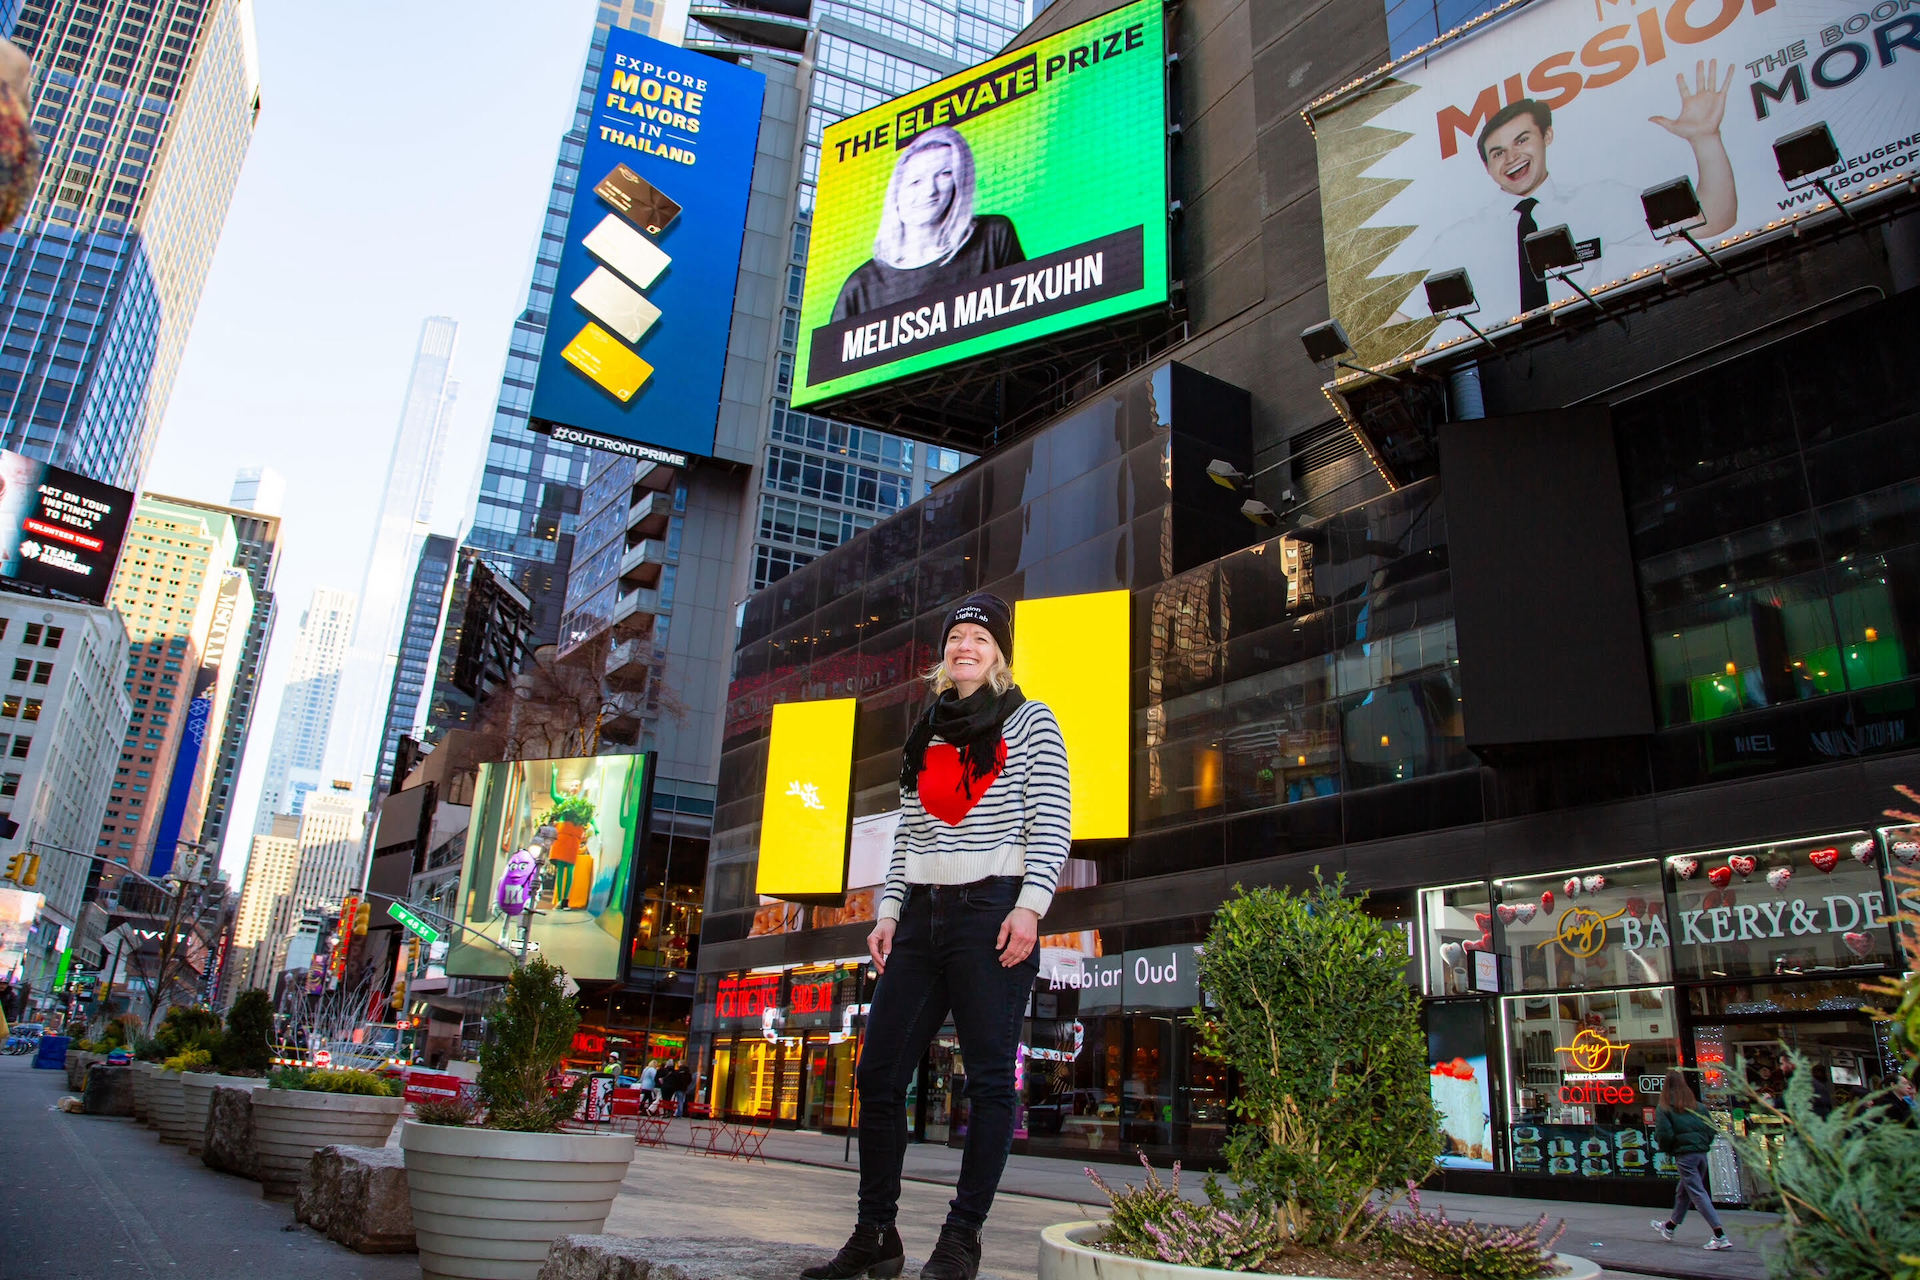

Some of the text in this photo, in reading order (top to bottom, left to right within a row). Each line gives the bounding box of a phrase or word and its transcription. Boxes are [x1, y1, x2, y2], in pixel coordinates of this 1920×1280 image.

[615, 53, 708, 92] EXPLORE
[1745, 39, 1808, 78] THE
[611, 69, 703, 115] MORE
[835, 23, 1144, 163] THE ELEVATE PRIZE
[1436, 0, 1776, 160] MISSIO
[606, 93, 700, 133] FLAVORS
[639, 121, 662, 138] IN
[600, 125, 696, 165] THAILAND
[841, 252, 1104, 363] MELISSA MALZKUHN
[553, 427, 685, 466] #OUTFRONTPRIME
[38, 484, 111, 514] ACT ON YOUR
[42, 496, 101, 521] INSTINCTS
[28, 521, 100, 548] VOLUNTEER TODAY
[45, 507, 93, 530] TO HELP.
[39, 552, 93, 576] RUBICON
[43, 544, 77, 562] TEAM
[955, 611, 973, 620] Light
[398, 911, 429, 937] W 48 St
[1134, 952, 1177, 985] Oud
[588, 1078, 599, 1120] CHICAGO
[1558, 1081, 1634, 1104] coffee
